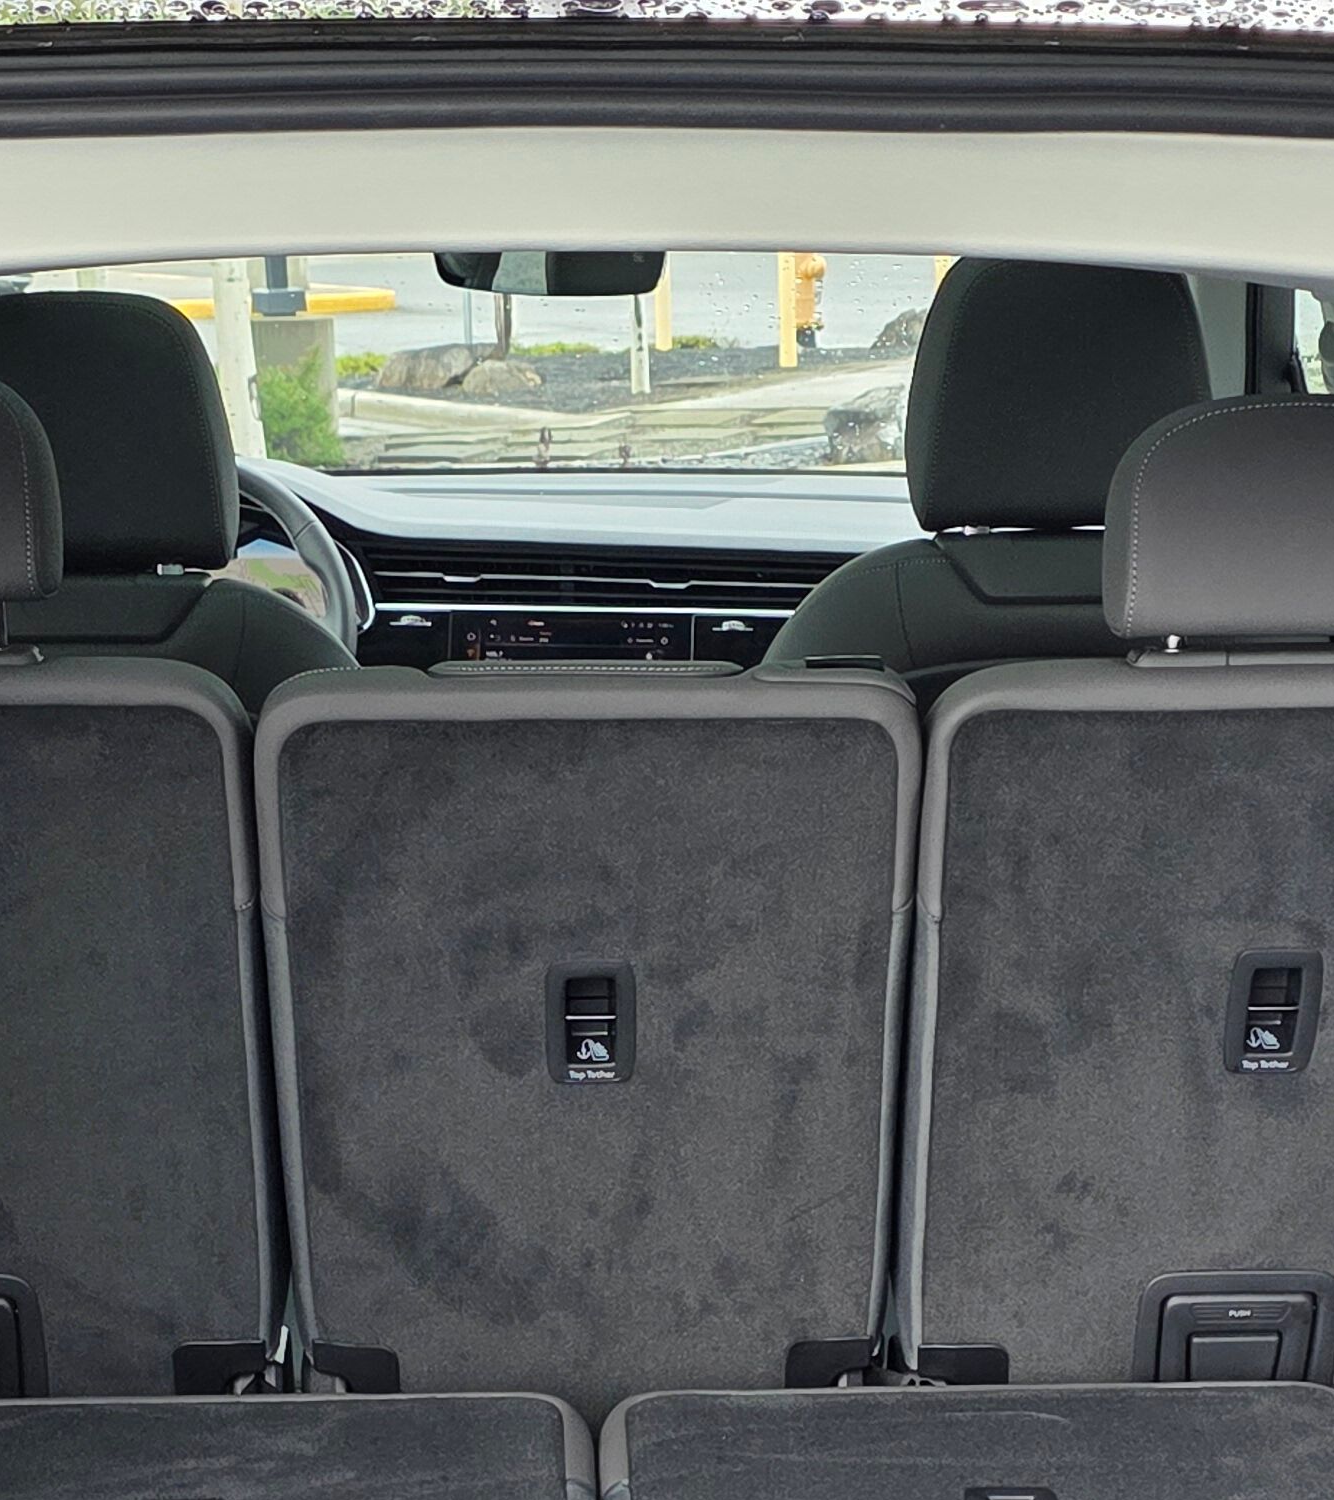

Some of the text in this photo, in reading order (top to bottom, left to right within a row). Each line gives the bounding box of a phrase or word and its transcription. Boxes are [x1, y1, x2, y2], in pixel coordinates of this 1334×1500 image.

[1241, 1060, 1289, 1071] Top Tether
[568, 1070, 616, 1081] Top Tether
[1228, 1309, 1252, 1318] PUSH
